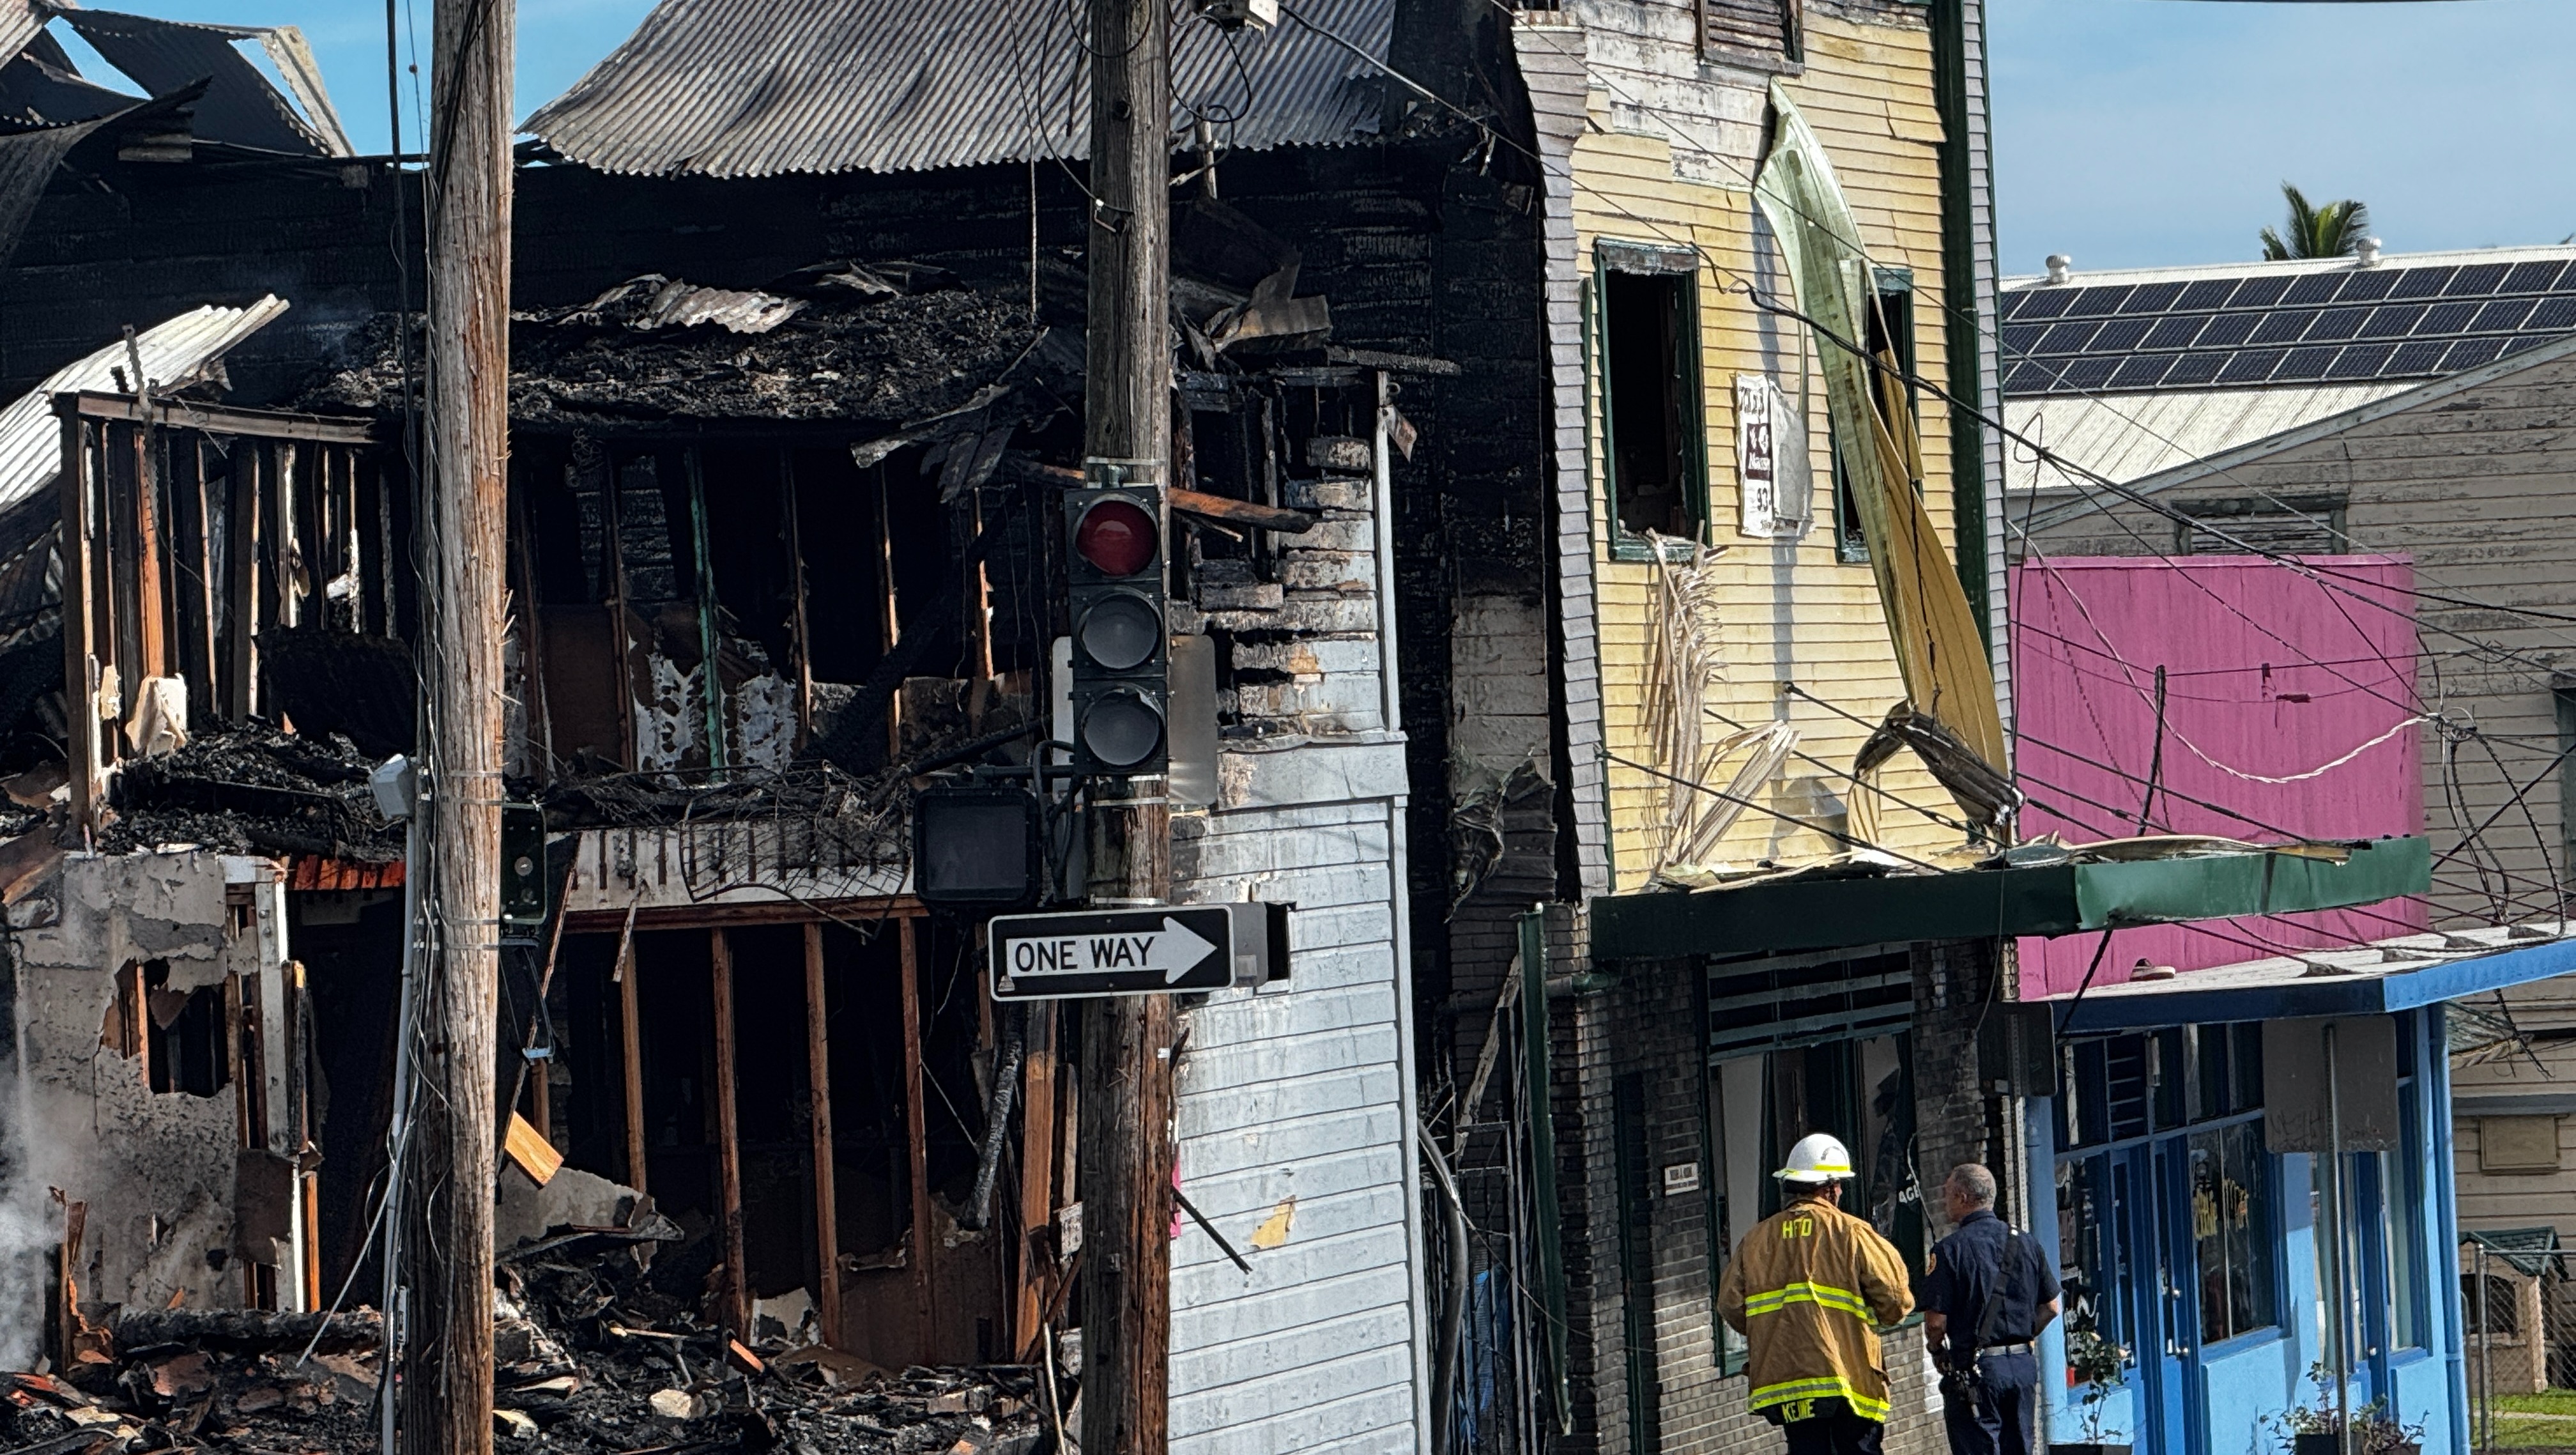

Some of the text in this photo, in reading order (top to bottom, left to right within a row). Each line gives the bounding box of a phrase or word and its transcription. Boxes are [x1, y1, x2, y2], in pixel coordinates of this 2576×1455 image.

[1015, 936, 1155, 972] ONE WAY
[1782, 1218, 1812, 1239] HFD
